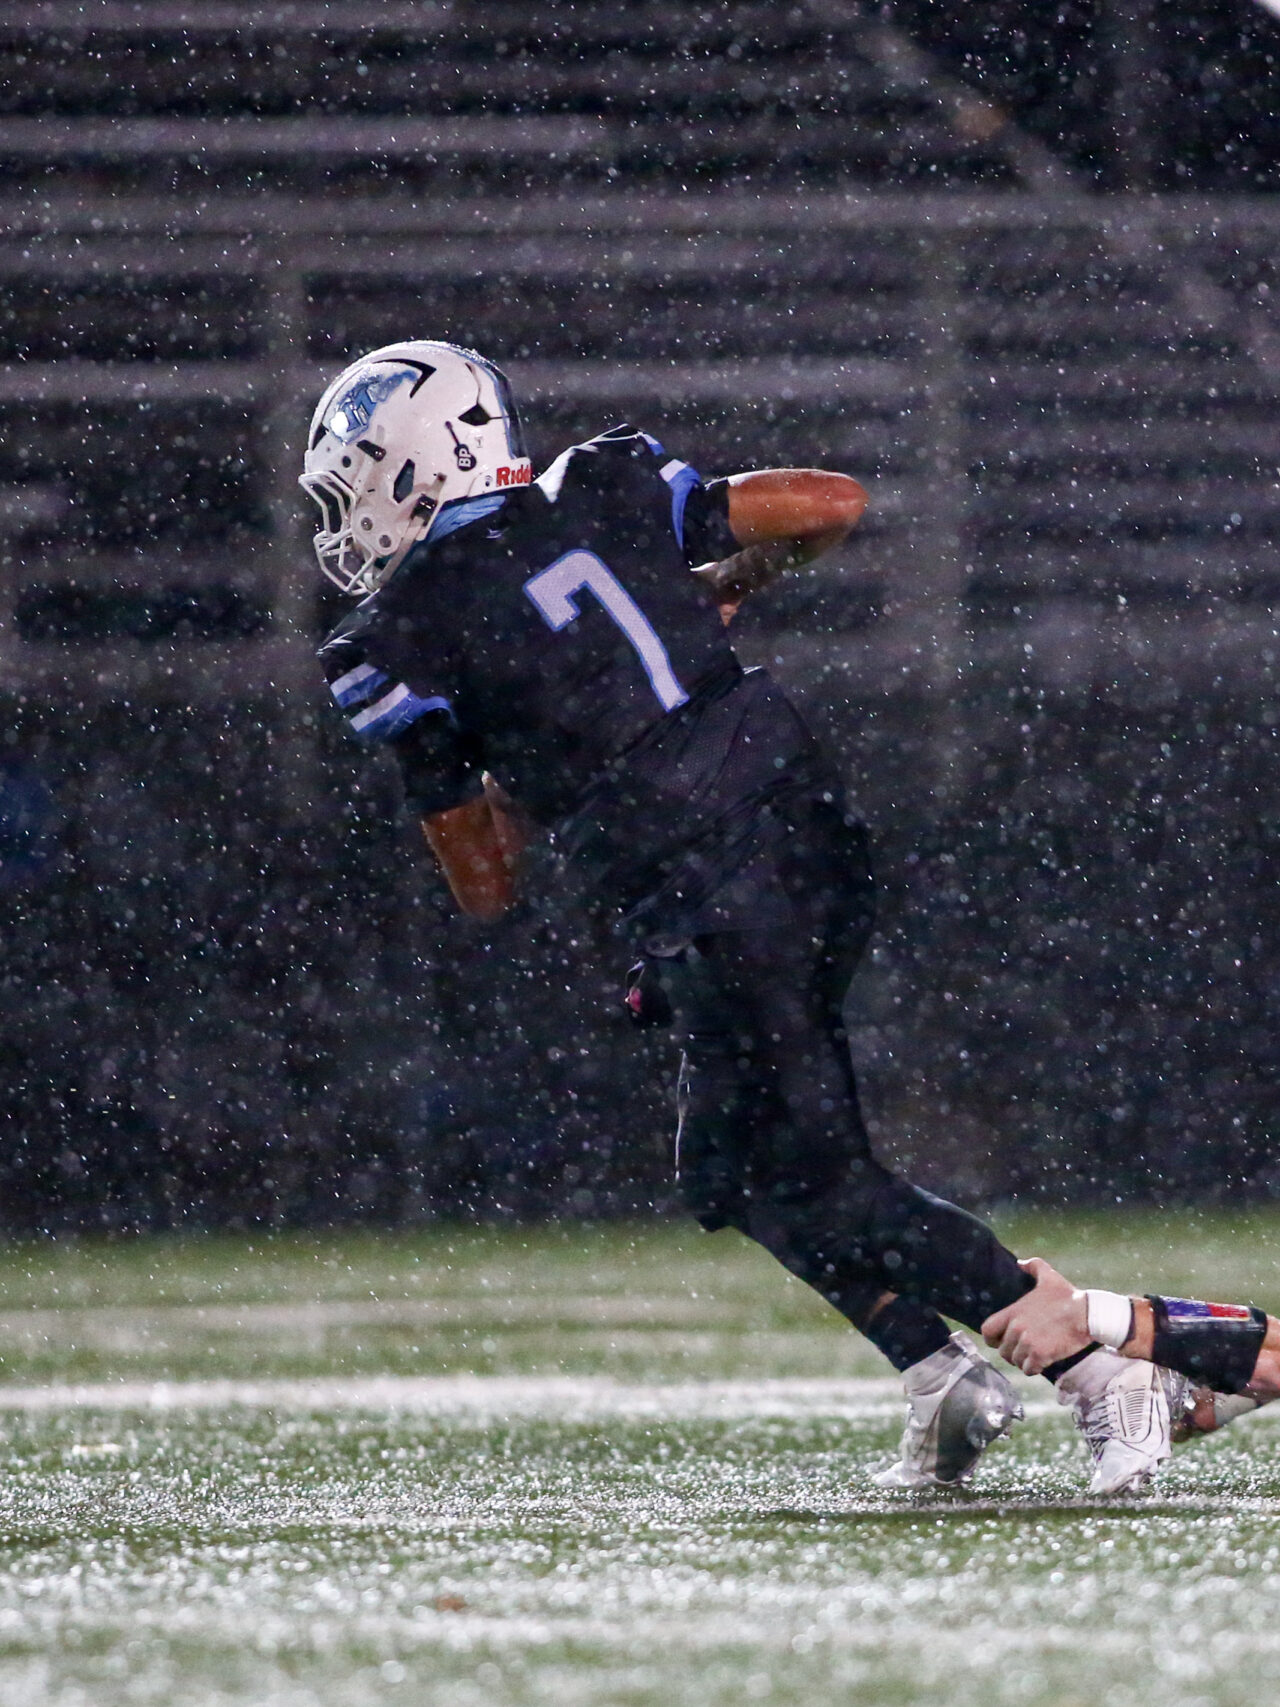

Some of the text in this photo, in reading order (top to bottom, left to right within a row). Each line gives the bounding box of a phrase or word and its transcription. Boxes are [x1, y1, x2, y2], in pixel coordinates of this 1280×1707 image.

[458, 447, 472, 468] BP
[495, 463, 532, 487] Ridd
[522, 548, 690, 713] 7
